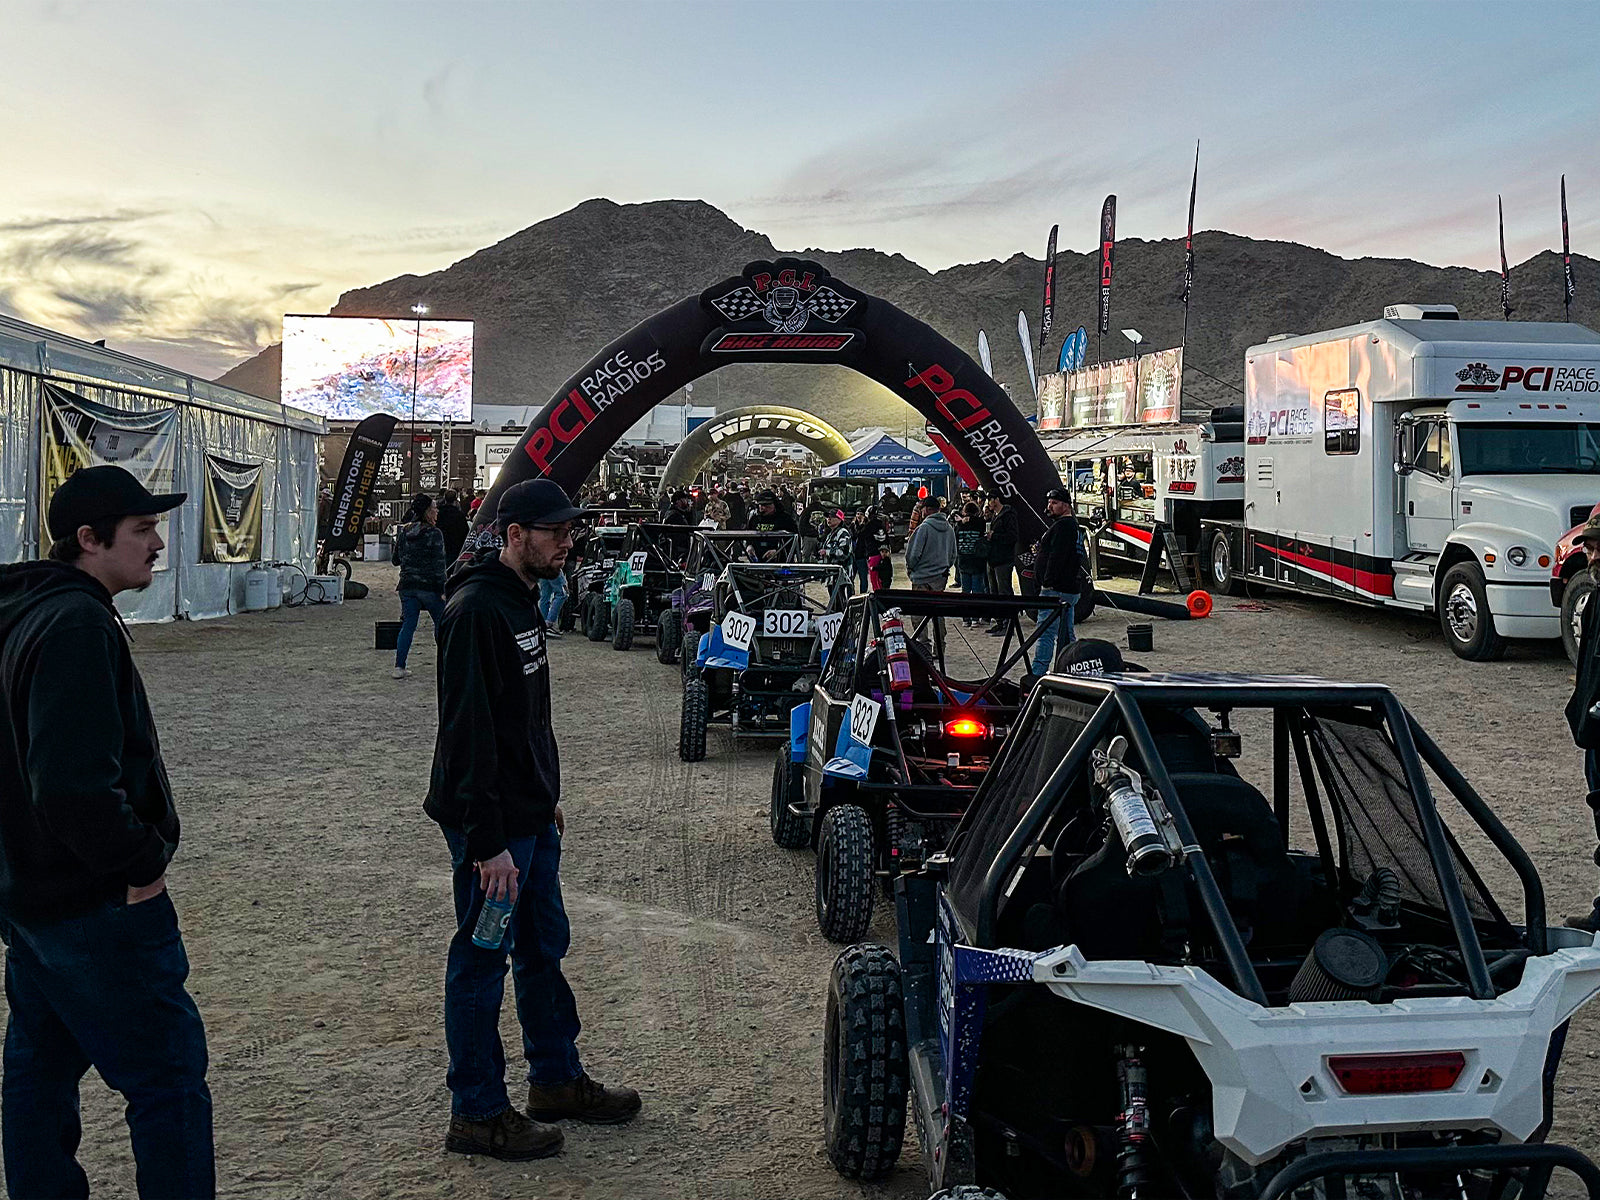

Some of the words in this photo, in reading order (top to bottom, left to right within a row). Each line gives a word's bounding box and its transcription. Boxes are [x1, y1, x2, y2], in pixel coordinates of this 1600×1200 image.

[580, 350, 633, 396] RACE
[591, 351, 667, 412] RADIOS
[1500, 366, 1555, 392] PCI
[1553, 380, 1600, 393] RADIO
[1556, 367, 1596, 380] RACE
[904, 363, 992, 432] PCI
[708, 413, 829, 444] NITTO
[1268, 409, 1290, 436] PCI
[1288, 421, 1314, 436] RADIOS
[1290, 408, 1308, 421] RACE
[524, 388, 597, 477] PCI
[981, 419, 1025, 471] RACE
[846, 467, 925, 476] KINGSHOCKS.COM
[964, 429, 1019, 499] RADIOS
[331, 449, 365, 537] GENERATORS
[348, 498, 364, 534] SOLD
[359, 460, 376, 496] HERE
[631, 555, 645, 571] 66
[726, 616, 751, 644] 302
[764, 612, 806, 635] 302
[1070, 658, 1103, 674] NORTH
[852, 698, 874, 741] 823
